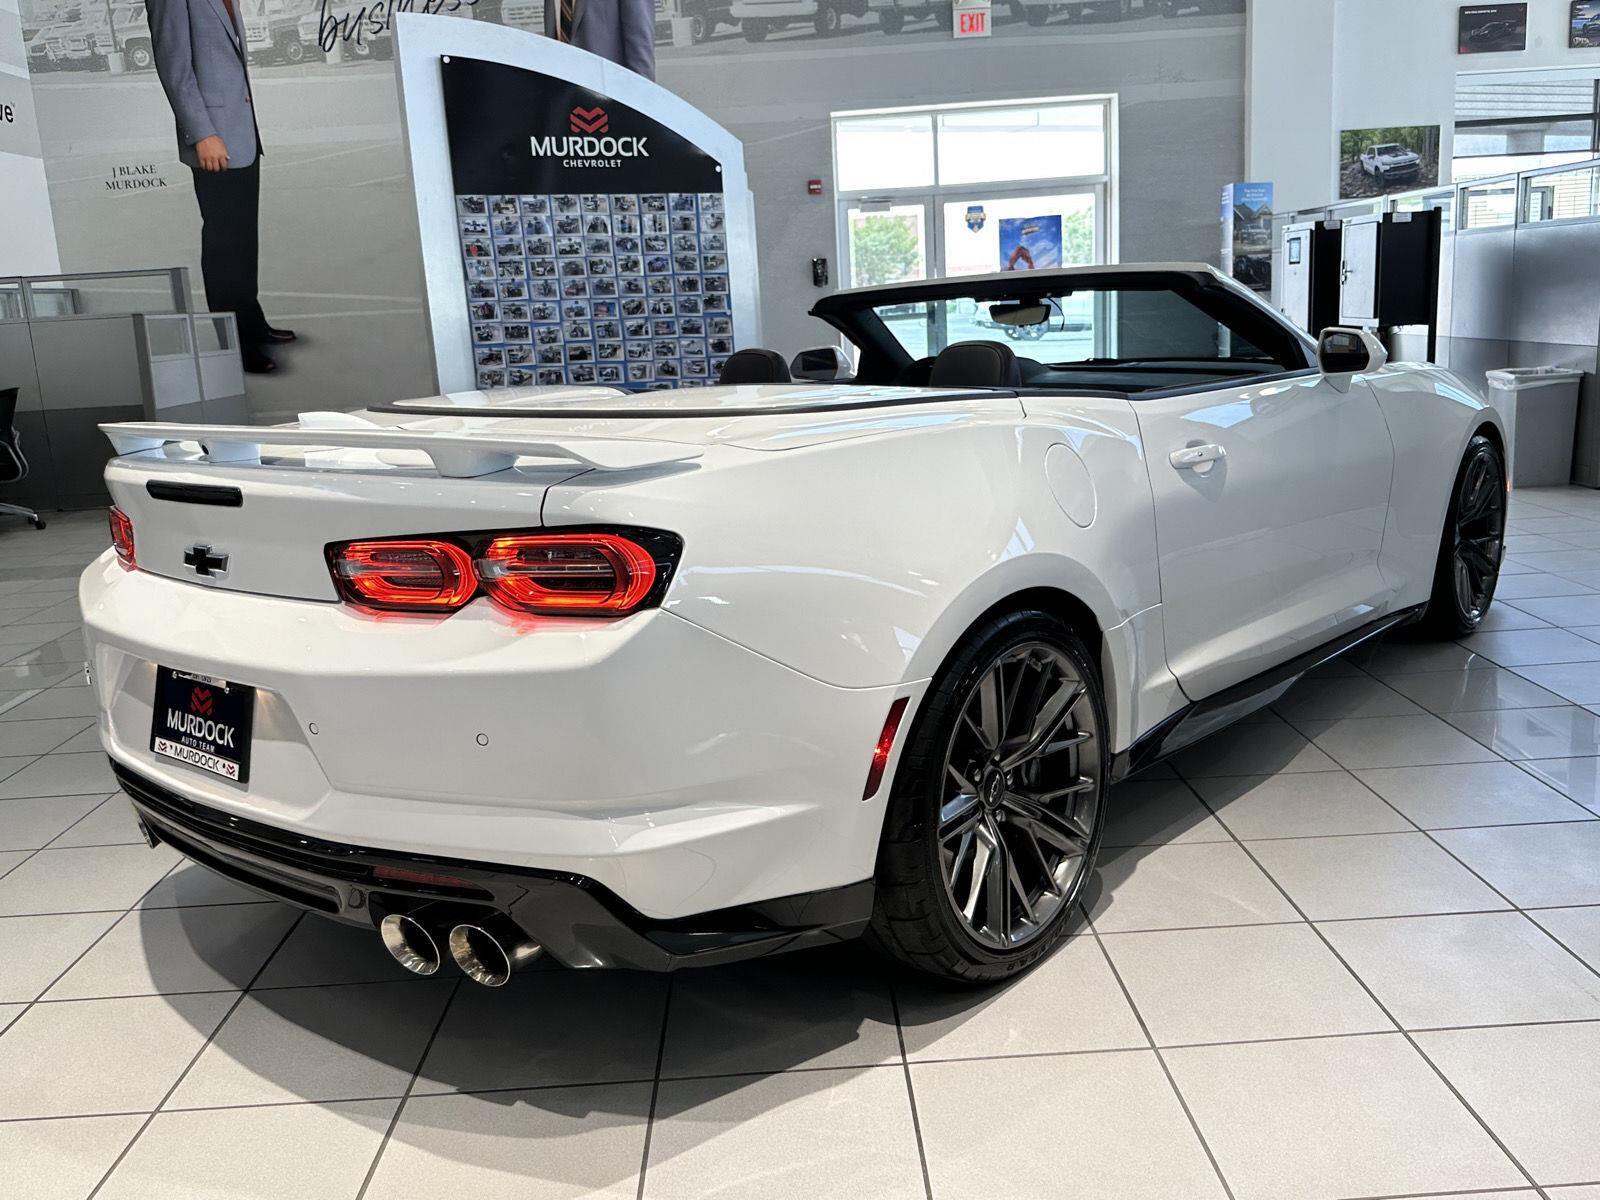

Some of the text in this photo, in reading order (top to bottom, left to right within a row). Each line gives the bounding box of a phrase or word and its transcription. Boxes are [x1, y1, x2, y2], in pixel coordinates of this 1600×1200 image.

[960, 13, 986, 32] EXIT
[530, 136, 650, 157] MURDOCK
[119, 164, 157, 176] BLAKE
[563, 159, 622, 168] CHEVROLET
[105, 177, 168, 190] MURDOCK
[167, 707, 236, 749] MURDOCK
[181, 735, 216, 753] AUTO TEAM
[174, 745, 221, 772] MURDOCK
